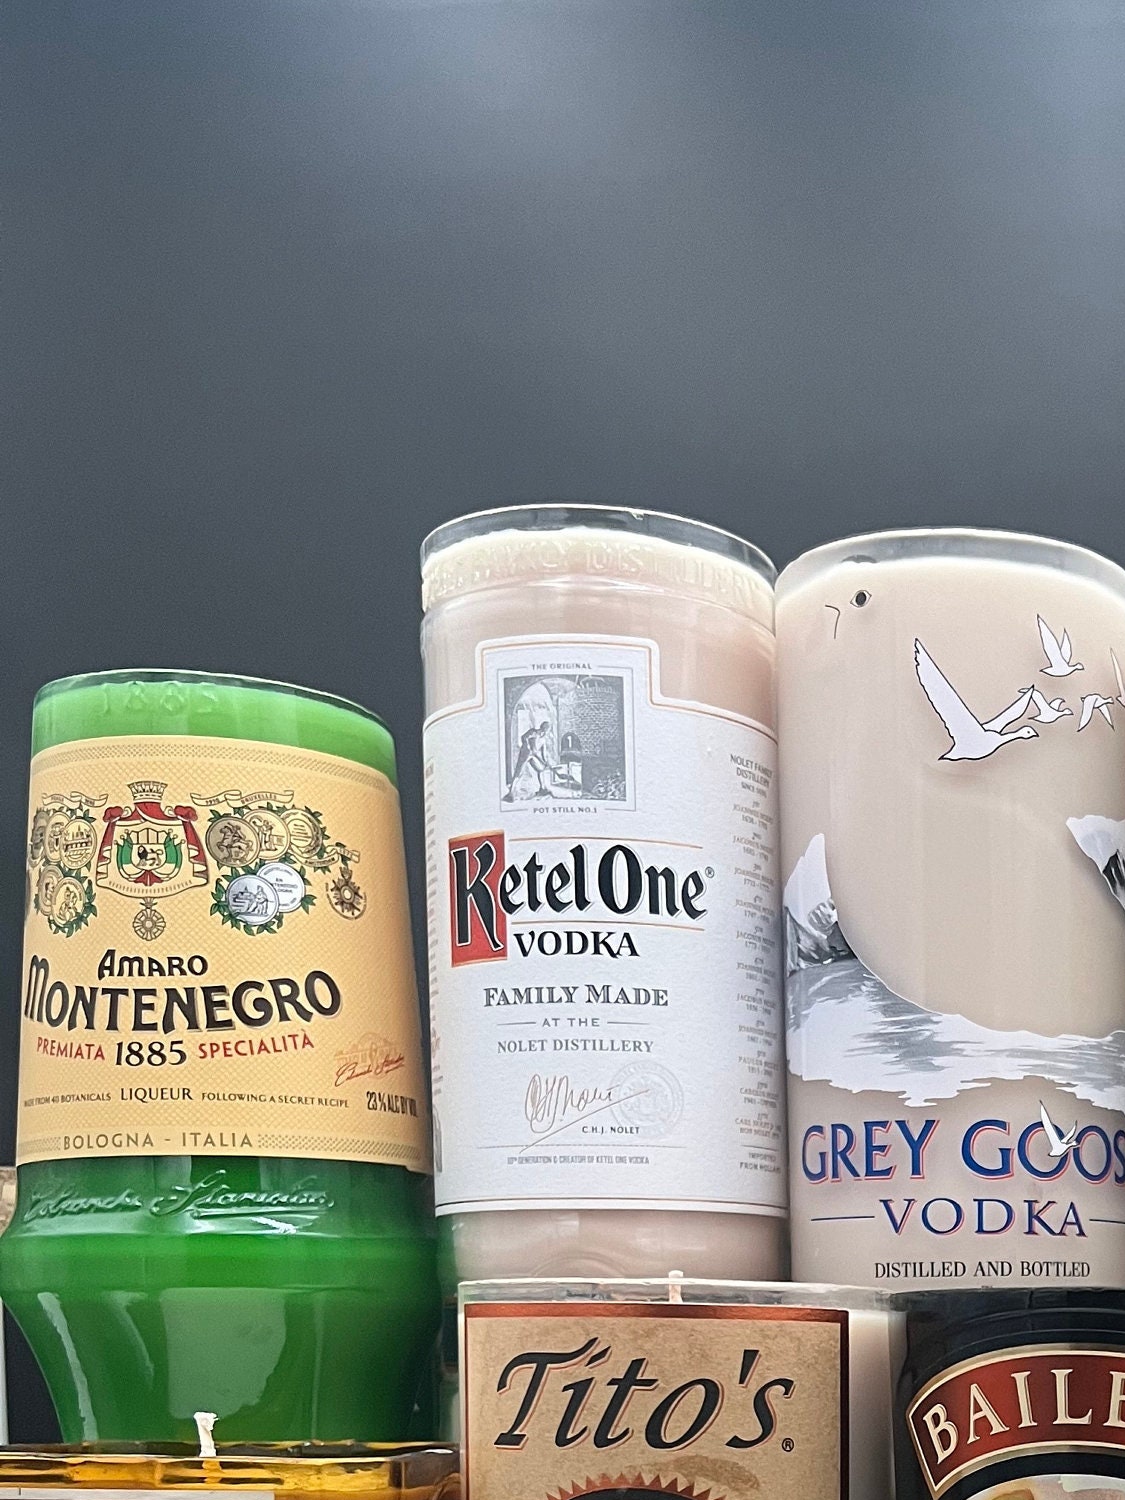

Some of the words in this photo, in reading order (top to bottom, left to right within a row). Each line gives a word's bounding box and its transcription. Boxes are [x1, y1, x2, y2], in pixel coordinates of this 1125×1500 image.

[451, 840, 591, 950] Ketel
[598, 844, 708, 920] One
[513, 930, 641, 958] VODKA
[24, 954, 342, 1034] MONTENEGRO
[484, 985, 578, 1007] FAMILY
[585, 984, 668, 1007] MADE
[542, 1018, 560, 1027] AT
[567, 1018, 600, 1027] THE
[37, 1037, 105, 1061] PREMIATA
[115, 1040, 187, 1067] 1885
[198, 1030, 314, 1060] SPECIALITÀ
[498, 1040, 548, 1053] NOLET
[553, 1039, 654, 1053] DISTILLERY
[121, 1088, 192, 1102] LIQUEUR
[201, 1092, 267, 1103] FOLLOWING
[317, 1097, 349, 1108] RECIPE
[63, 1133, 154, 1150] BOLOGNA
[182, 1132, 253, 1147] ITALIA
[610, 1126, 639, 1134] NOLET
[802, 1119, 939, 1184] GREY
[879, 1197, 1088, 1238] VODKA
[875, 1261, 965, 1279] DISTILLED
[974, 1261, 1012, 1278] AND
[1021, 1261, 1090, 1278] BOTTLED
[494, 1337, 795, 1451] Tito's
